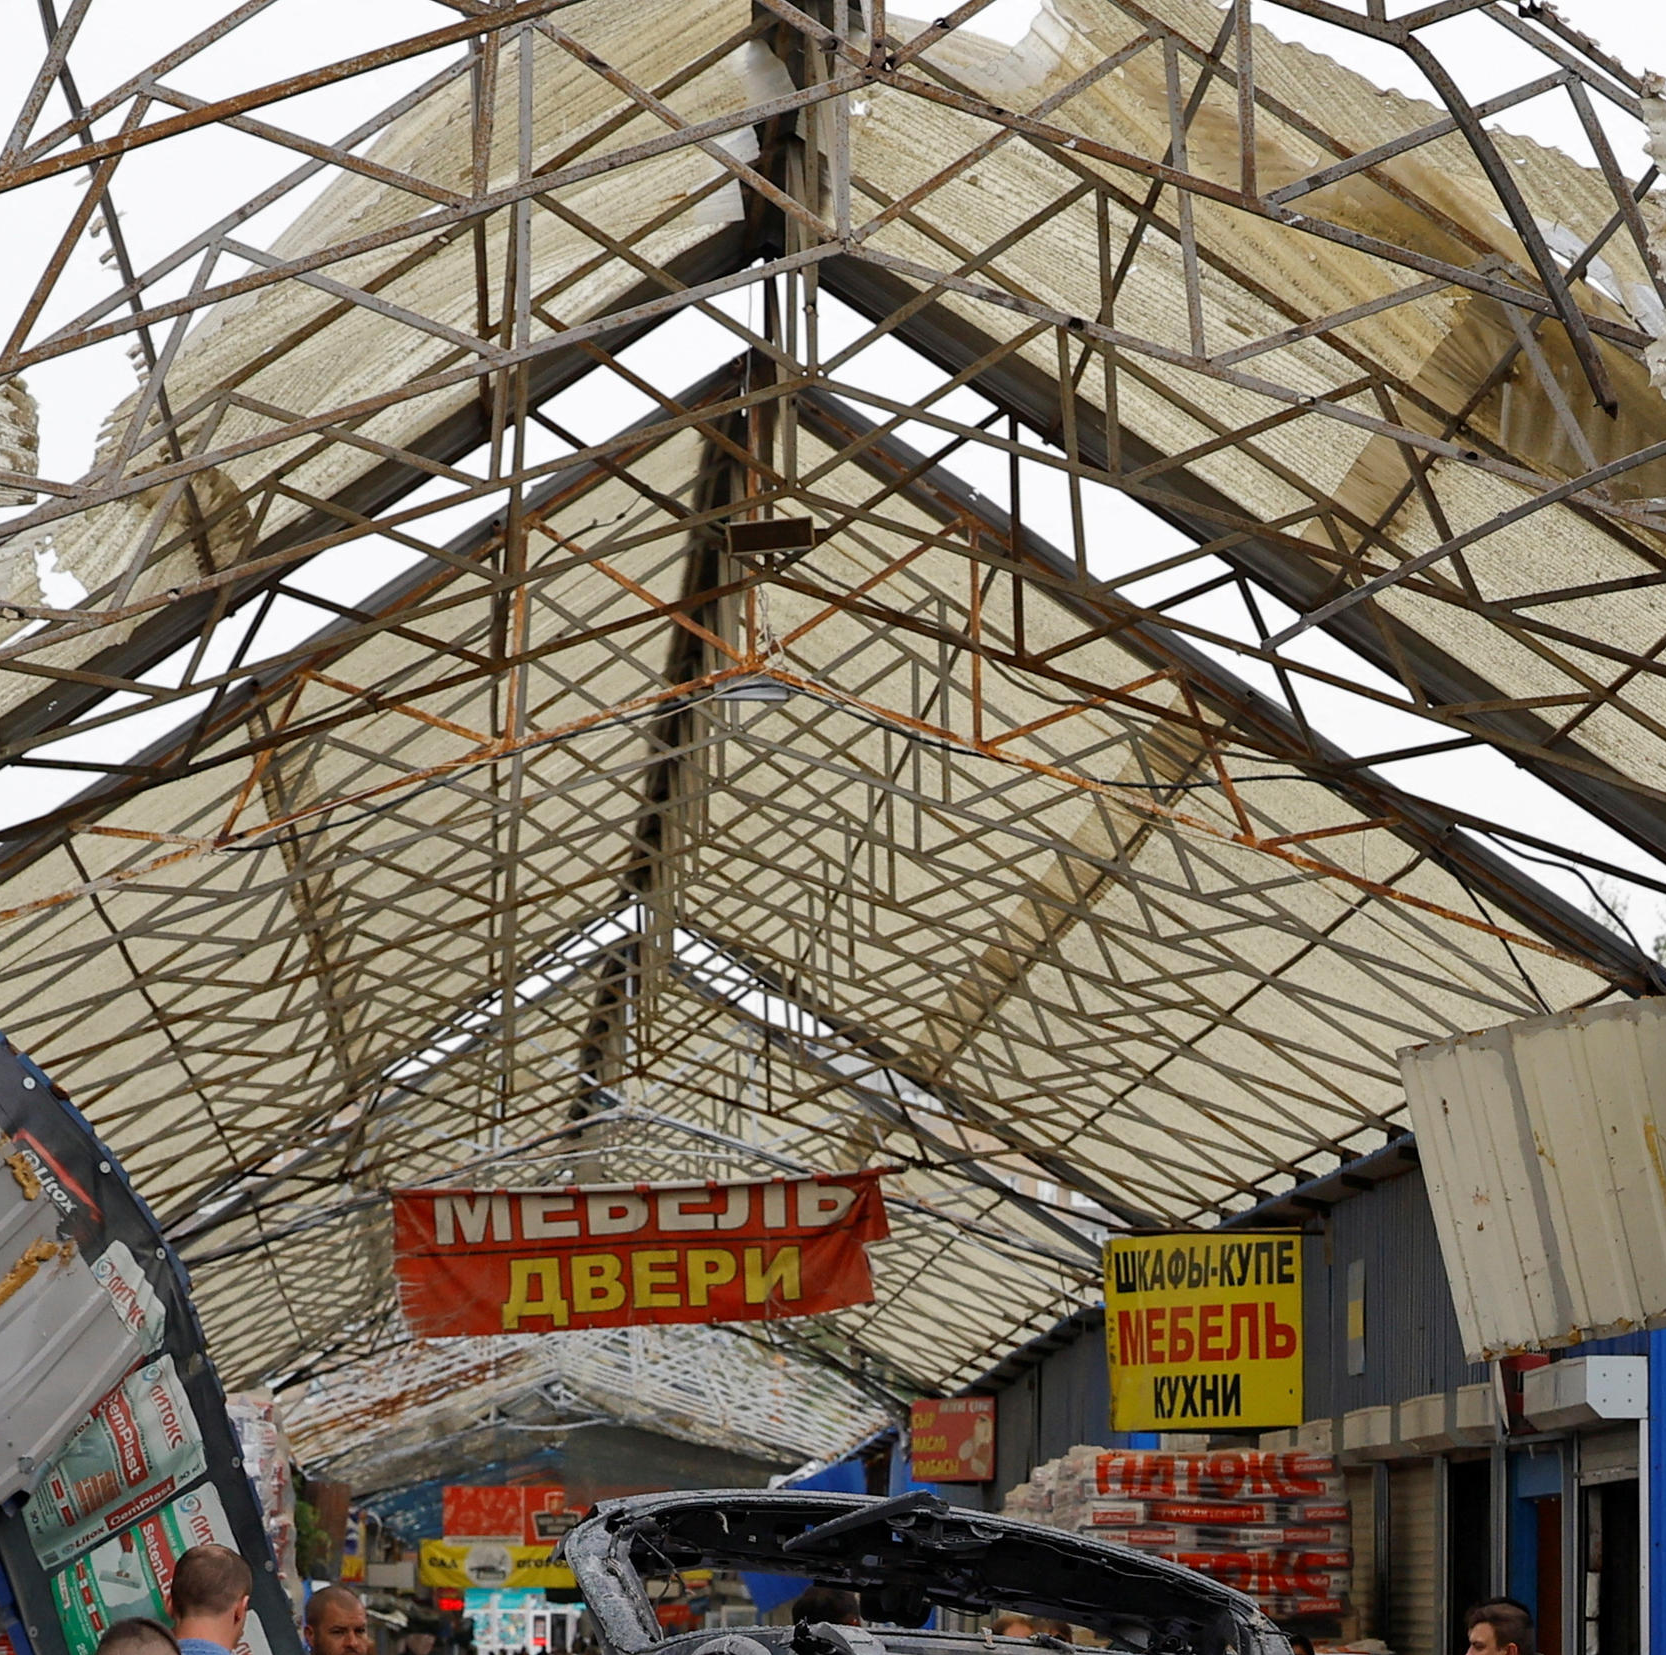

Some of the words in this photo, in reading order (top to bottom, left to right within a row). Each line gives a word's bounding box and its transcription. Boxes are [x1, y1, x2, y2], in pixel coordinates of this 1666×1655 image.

[501, 1245, 802, 1331] ДВЕРИ
[1114, 1240, 1295, 1294] ШКАФЫ-КУПЕ
[1117, 1301, 1297, 1367] МЕБЕЛЬ
[1153, 1373, 1242, 1419] КУХНИ
